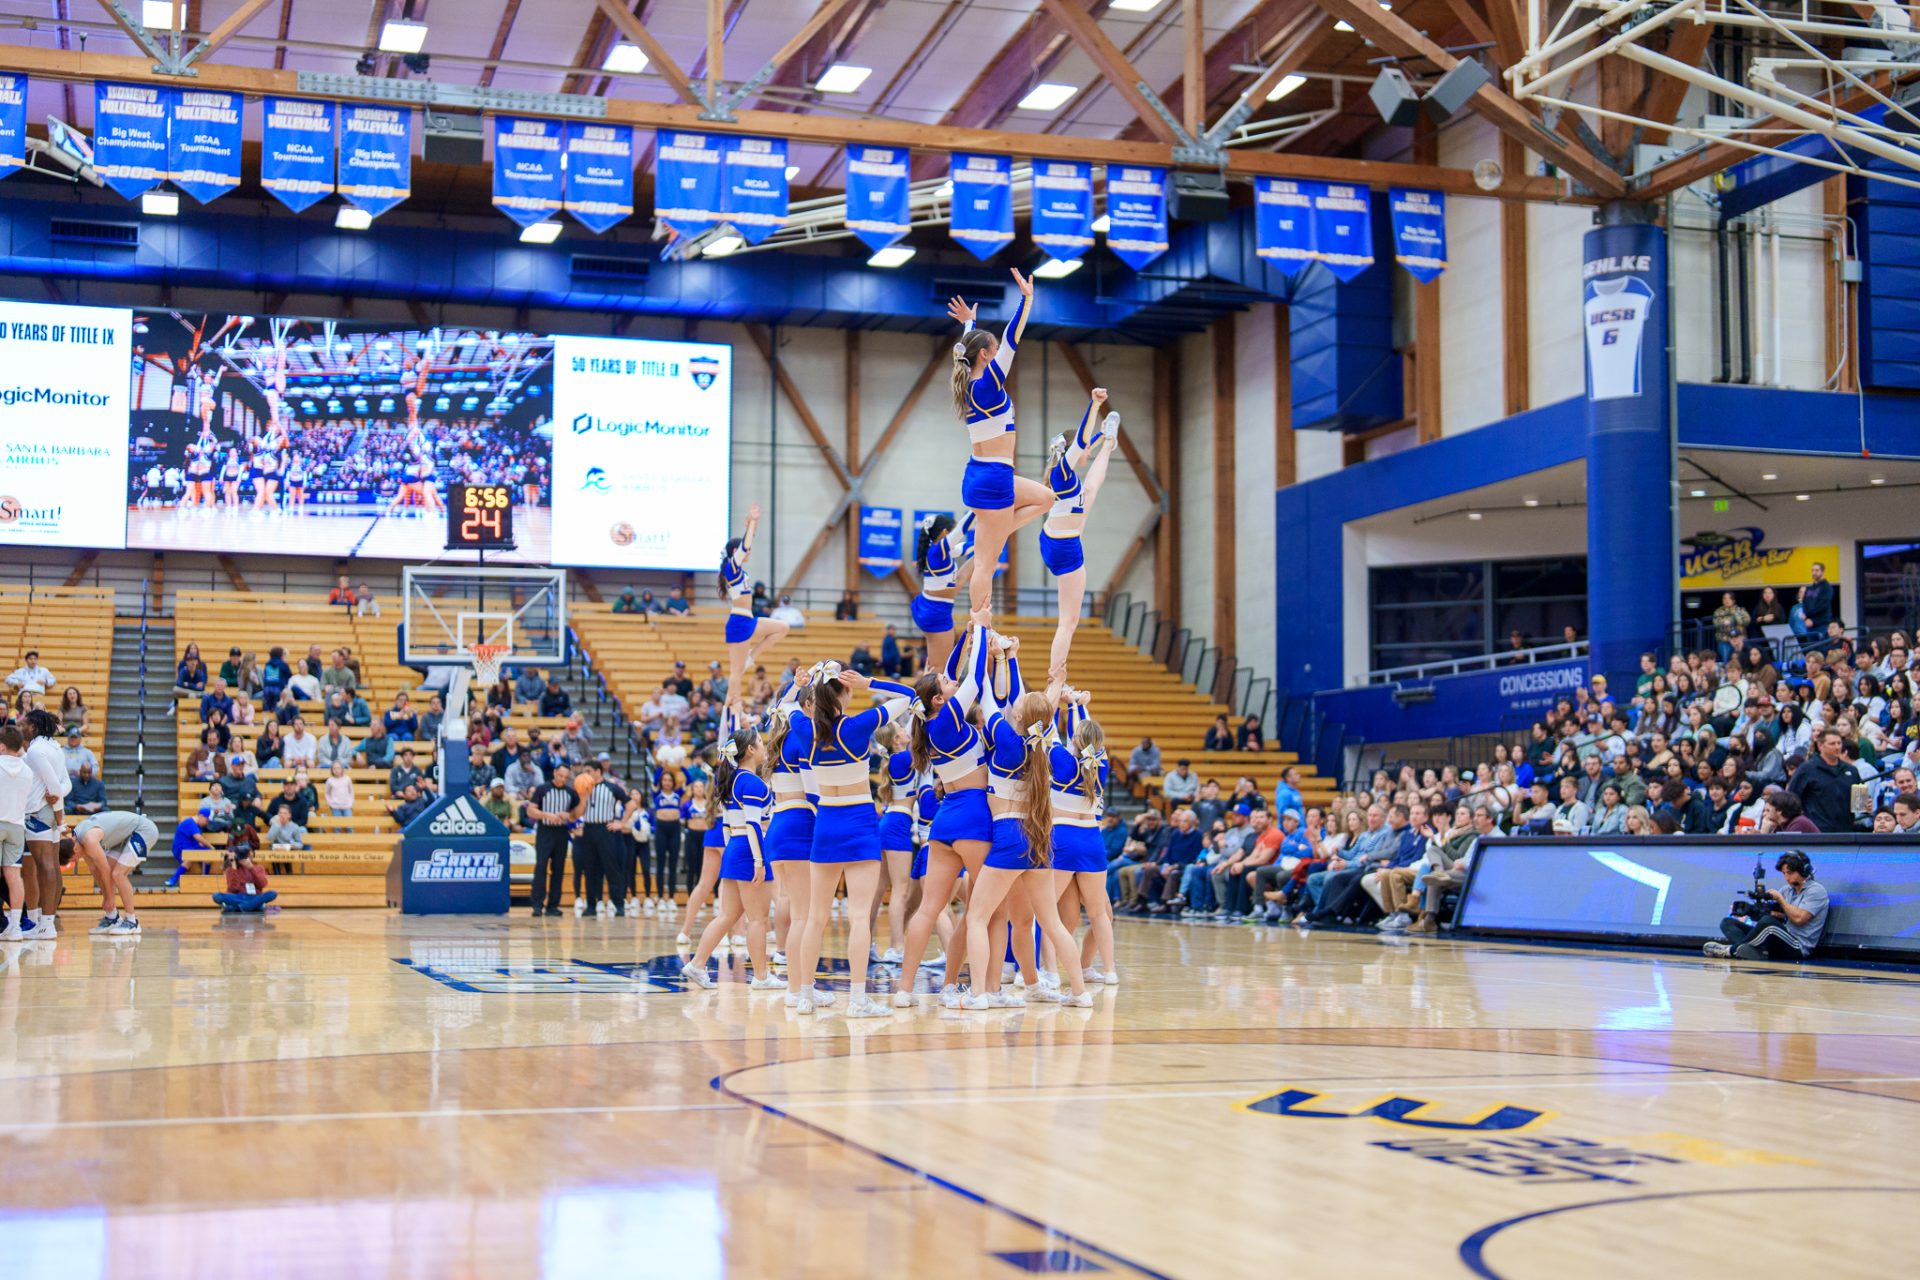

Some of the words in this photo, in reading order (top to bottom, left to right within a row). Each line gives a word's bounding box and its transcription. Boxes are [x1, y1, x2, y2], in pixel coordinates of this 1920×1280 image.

[107, 86, 158, 103] WOMEN'S
[182, 92, 232, 109] WOMEN'S
[100, 99, 165, 118] VOLLEYBALL
[175, 105, 239, 124] VOLLEYBALL
[268, 114, 331, 133] VOLLEYBALL
[347, 119, 405, 137] VOLLEYBALL
[112, 127, 127, 138] Big
[128, 128, 151, 139] West
[194, 134, 220, 146] NCAA
[97, 136, 165, 151] Championships
[180, 143, 231, 156] Tournament
[286, 143, 314, 154] NCAA
[272, 151, 325, 164] Tournament
[349, 156, 401, 170] Champions
[355, 148, 370, 160] Big
[371, 150, 396, 161] West
[105, 165, 156, 180] 2005
[504, 169, 554, 181] Tournament
[516, 162, 543, 173] NCAA
[586, 166, 614, 177] NCAA
[1591, 308, 1636, 326] UCSB
[0, 322, 7, 339] 0
[11, 322, 48, 341] YEARS
[52, 325, 66, 342] OF
[70, 326, 98, 344] TITLE
[102, 328, 114, 345] IX
[1602, 328, 1620, 346] 6
[572, 356, 586, 372] 50
[590, 358, 621, 374] YEARS
[626, 360, 636, 375] OF
[641, 360, 665, 376] TITLE
[596, 418, 711, 437] LogicMonitor
[5, 443, 48, 454] SANTA
[51, 445, 111, 457] BARBARA
[465, 487, 509, 508] 6:56
[462, 507, 502, 540] 24
[1684, 539, 1752, 577] UCSB
[1722, 554, 1763, 579] Snack
[1766, 547, 1794, 567] Bar
[1500, 667, 1583, 696] CONCESSIONS
[429, 819, 487, 835] adidas
[319, 853, 340, 861] Keep
[432, 850, 498, 867] SANTA
[412, 861, 502, 881] BARBARA
